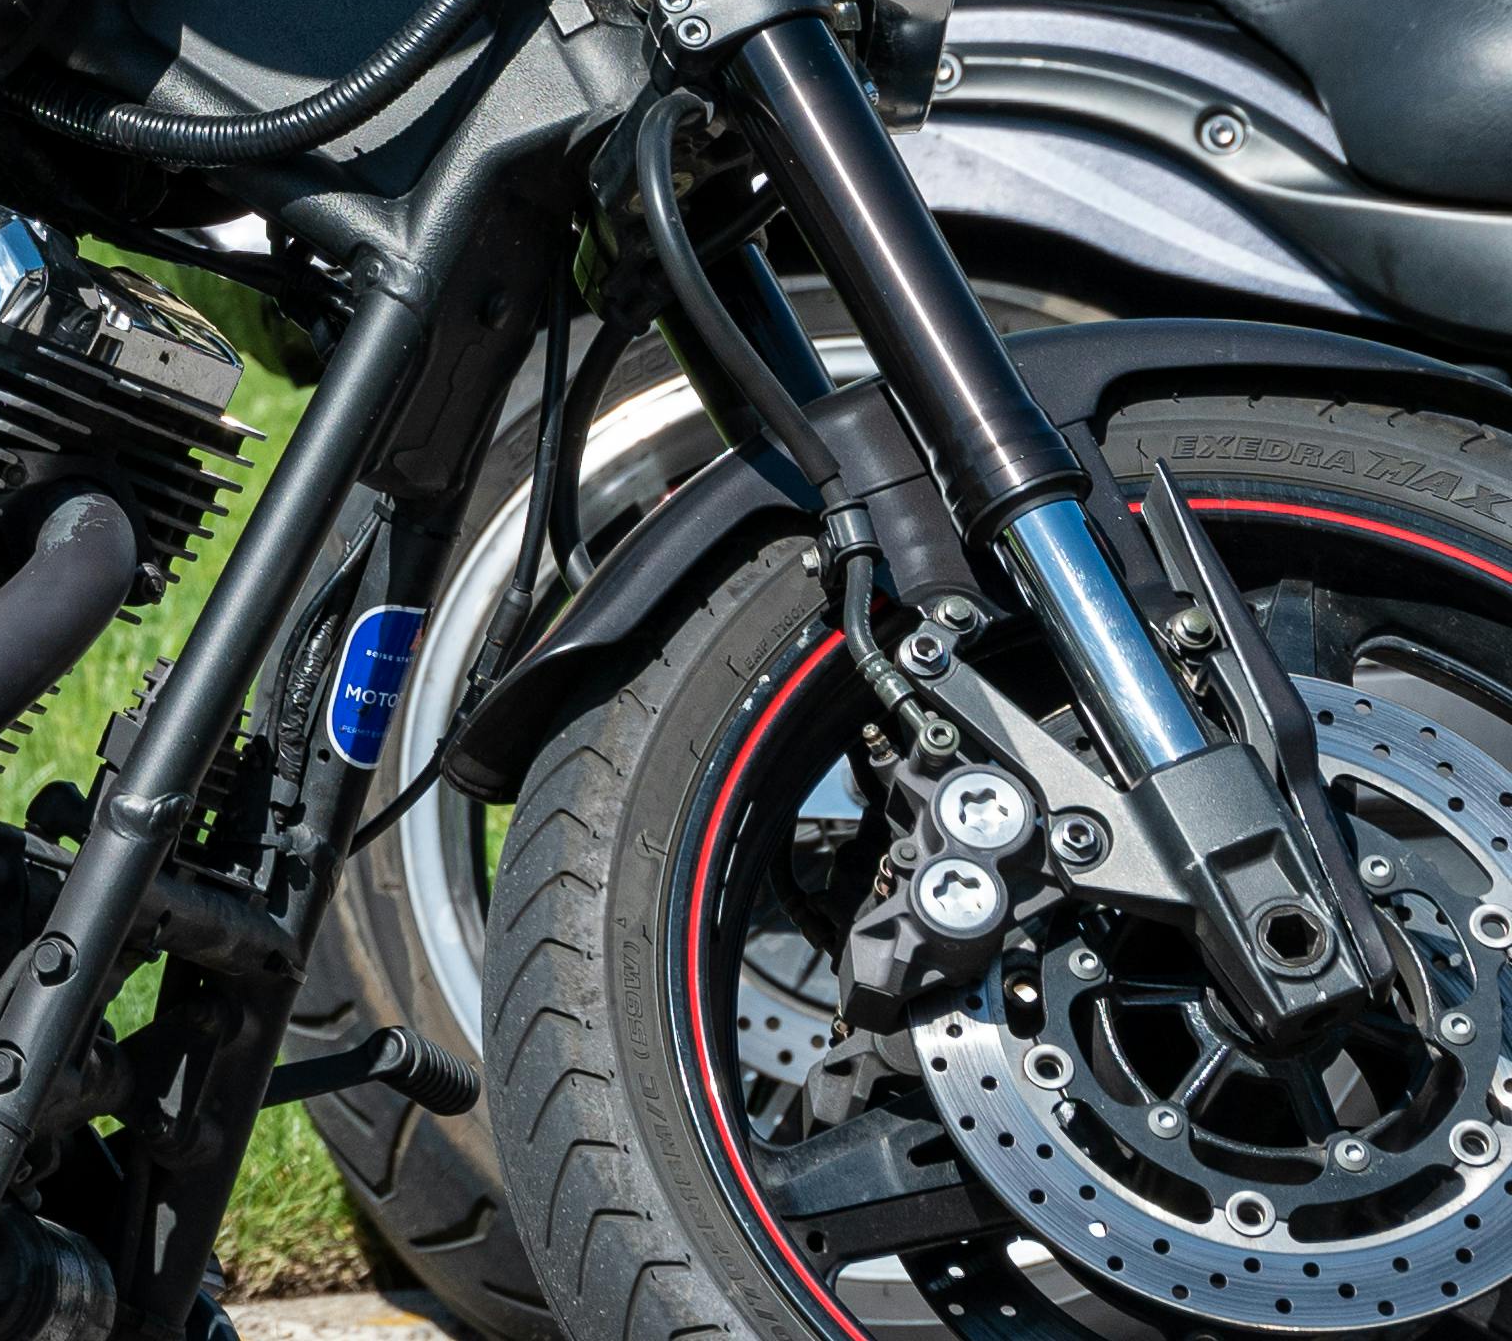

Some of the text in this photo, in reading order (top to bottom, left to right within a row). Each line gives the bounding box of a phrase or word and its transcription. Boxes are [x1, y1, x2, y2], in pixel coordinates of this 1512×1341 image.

[1171, 432, 1512, 524] EXEDRA MAX
[344, 683, 403, 709] MOTO
